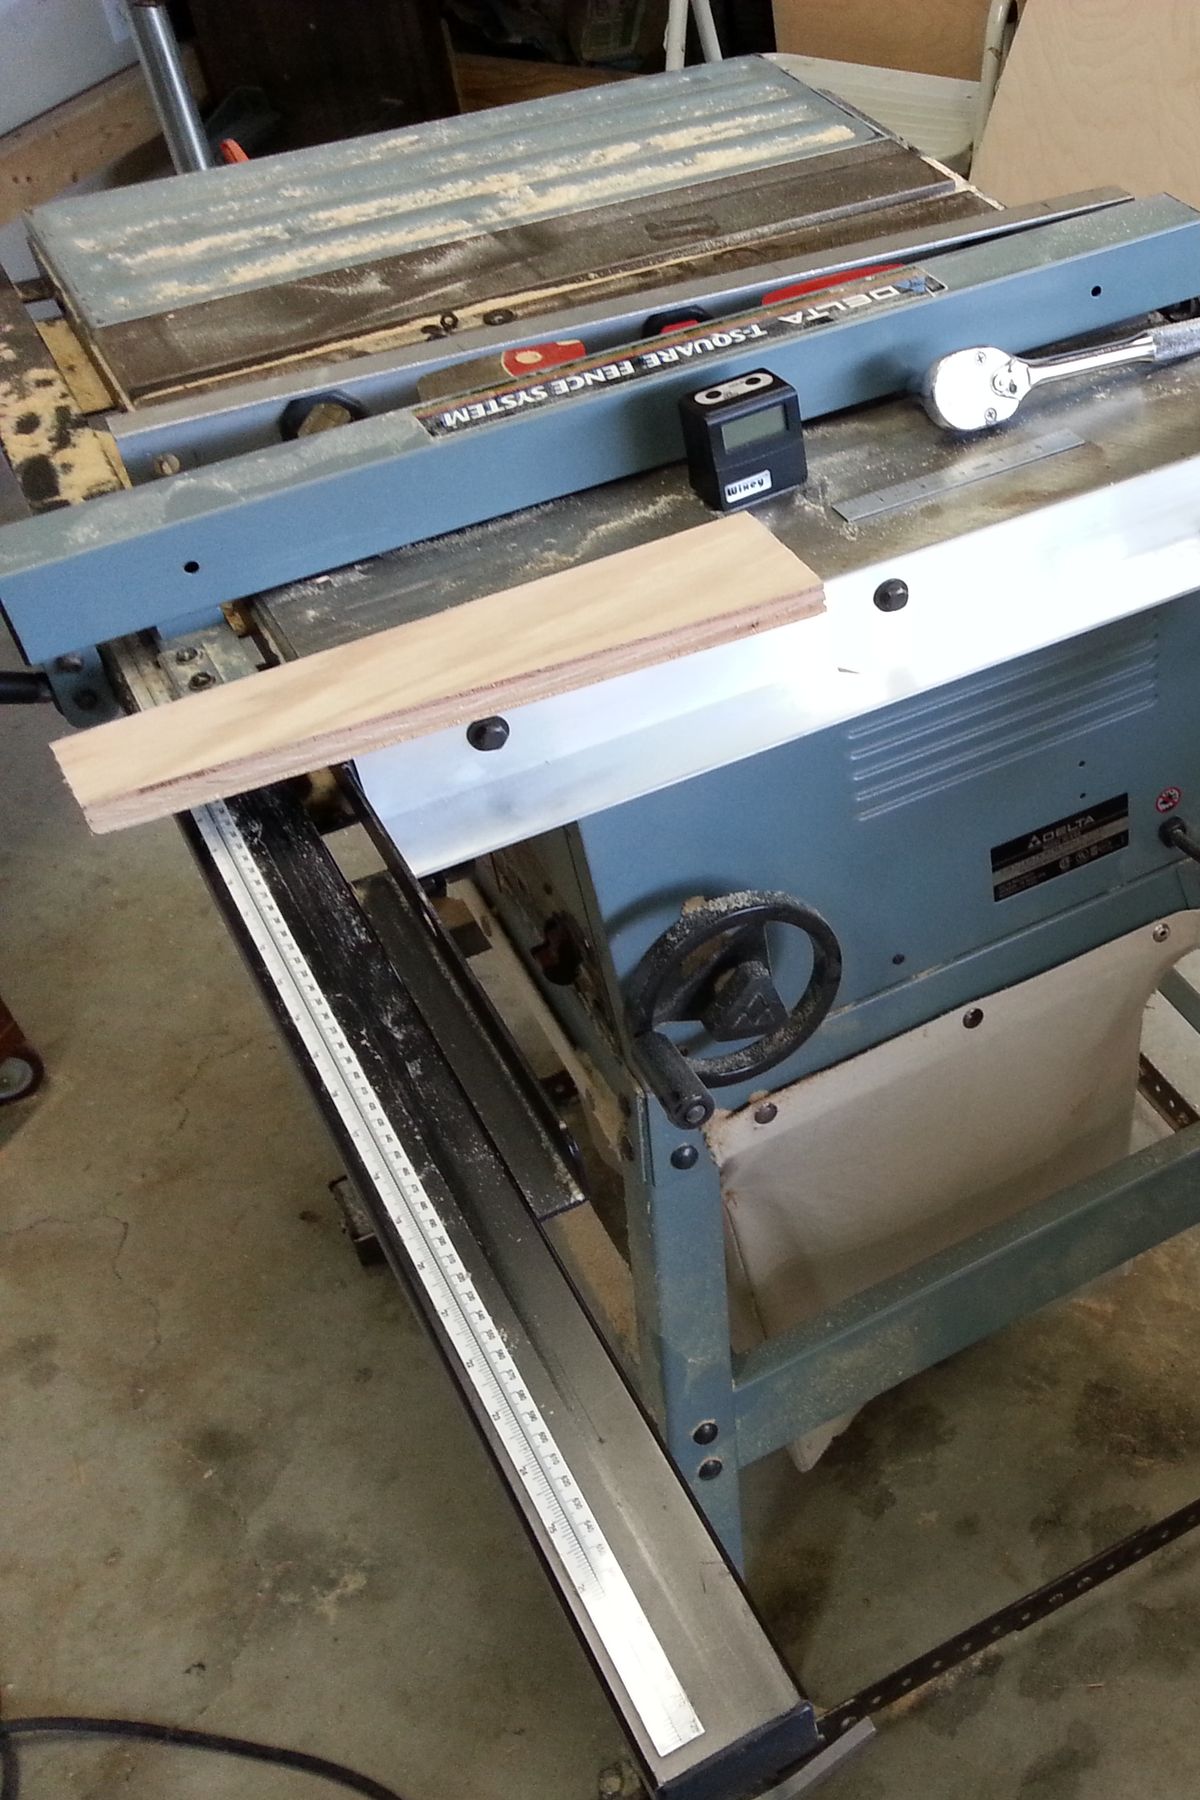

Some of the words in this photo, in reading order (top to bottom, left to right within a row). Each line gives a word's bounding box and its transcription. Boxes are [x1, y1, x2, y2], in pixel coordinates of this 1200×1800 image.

[778, 285, 900, 324] DELTA
[642, 323, 768, 369] T-SQUARE
[551, 360, 635, 395] FENCE
[443, 385, 548, 427] SYSTEM
[1043, 815, 1095, 842] DELTA
